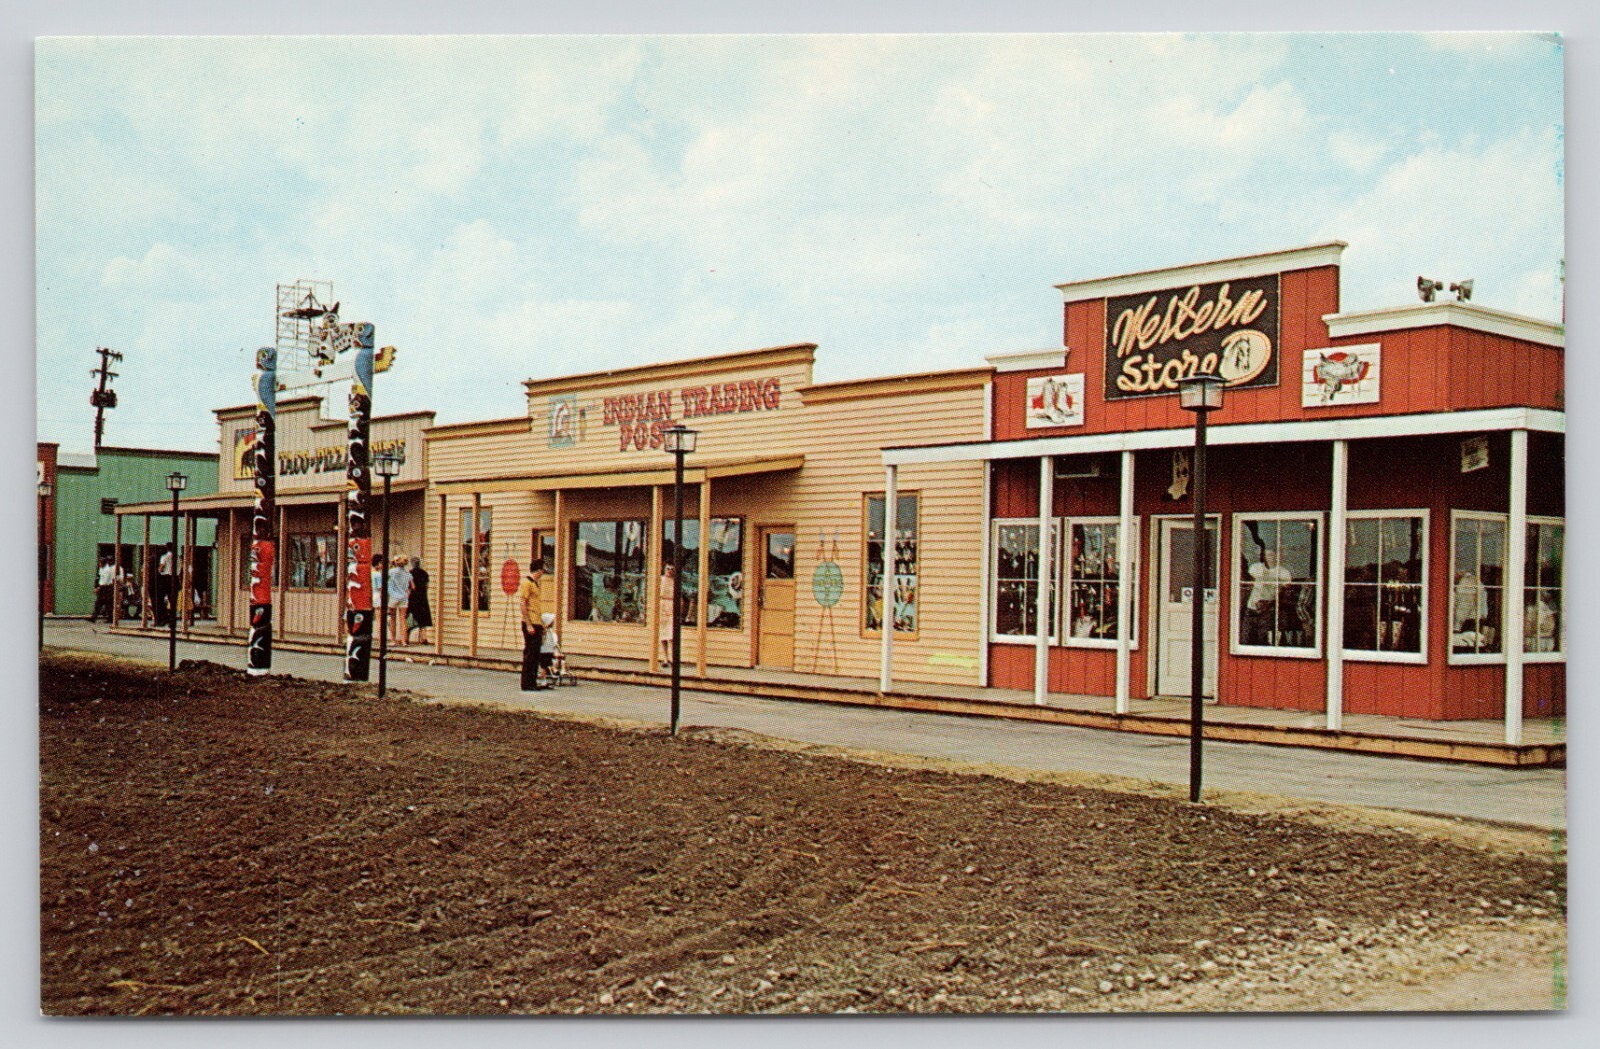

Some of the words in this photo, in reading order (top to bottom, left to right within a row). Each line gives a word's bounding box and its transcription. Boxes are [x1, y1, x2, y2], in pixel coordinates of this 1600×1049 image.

[1112, 283, 1267, 358] Western
[603, 390, 674, 426] INDIAN
[680, 377, 781, 419] TRADING
